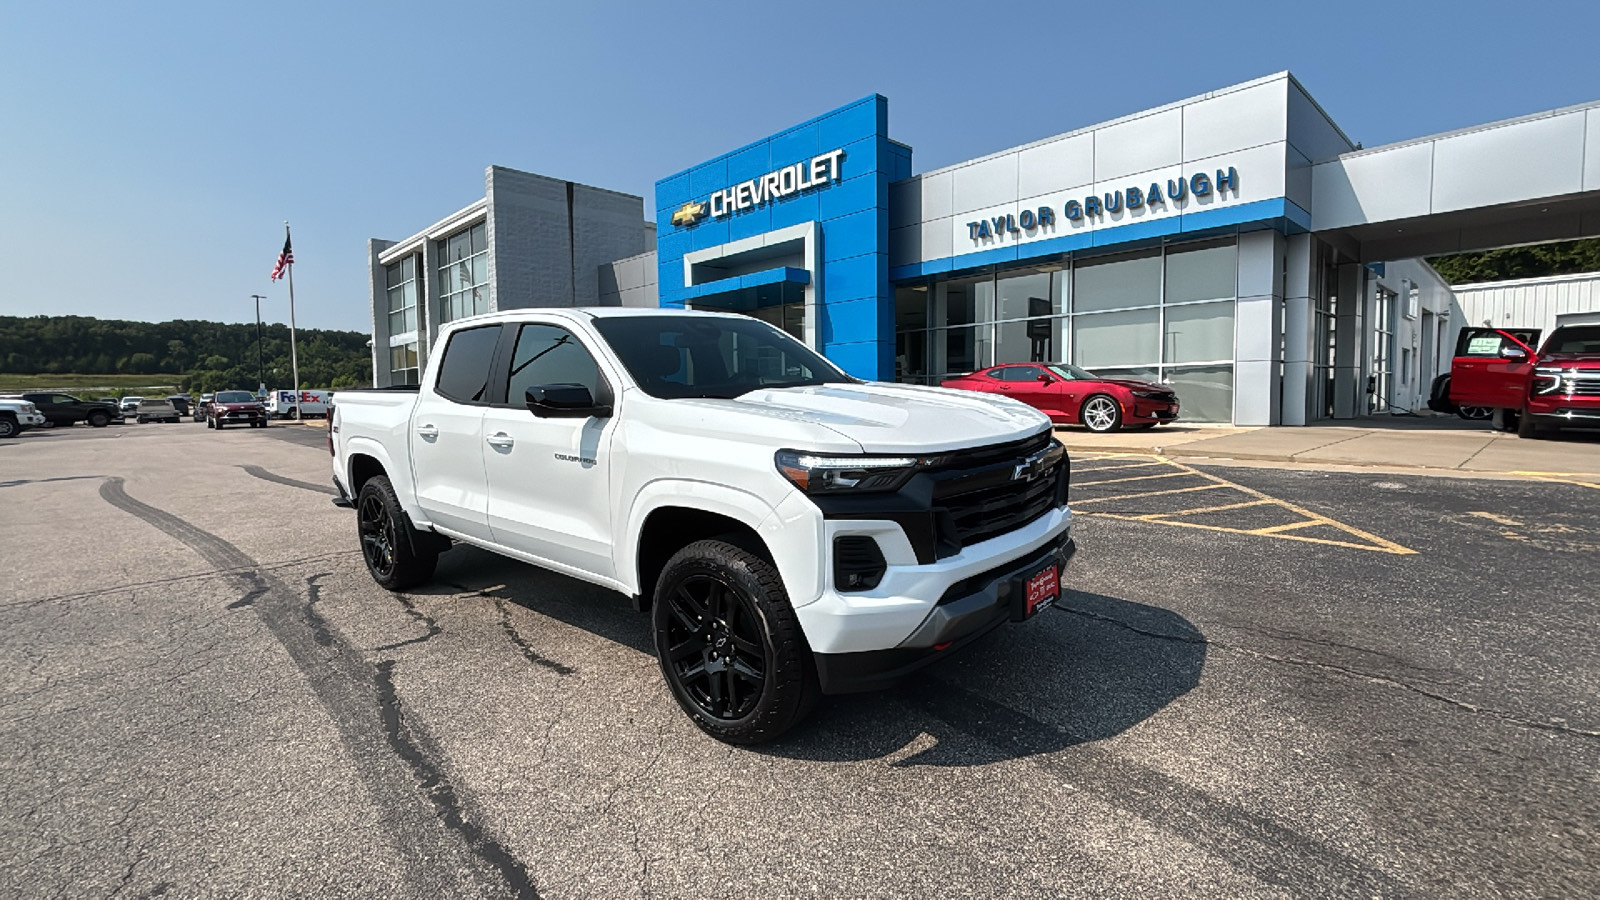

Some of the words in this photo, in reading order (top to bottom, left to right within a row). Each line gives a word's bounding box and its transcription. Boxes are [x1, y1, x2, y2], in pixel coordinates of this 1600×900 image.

[710, 148, 843, 217] CHEVROLET
[966, 206, 1053, 240] TAYLOR
[1064, 166, 1235, 220] GRUBAUGH
